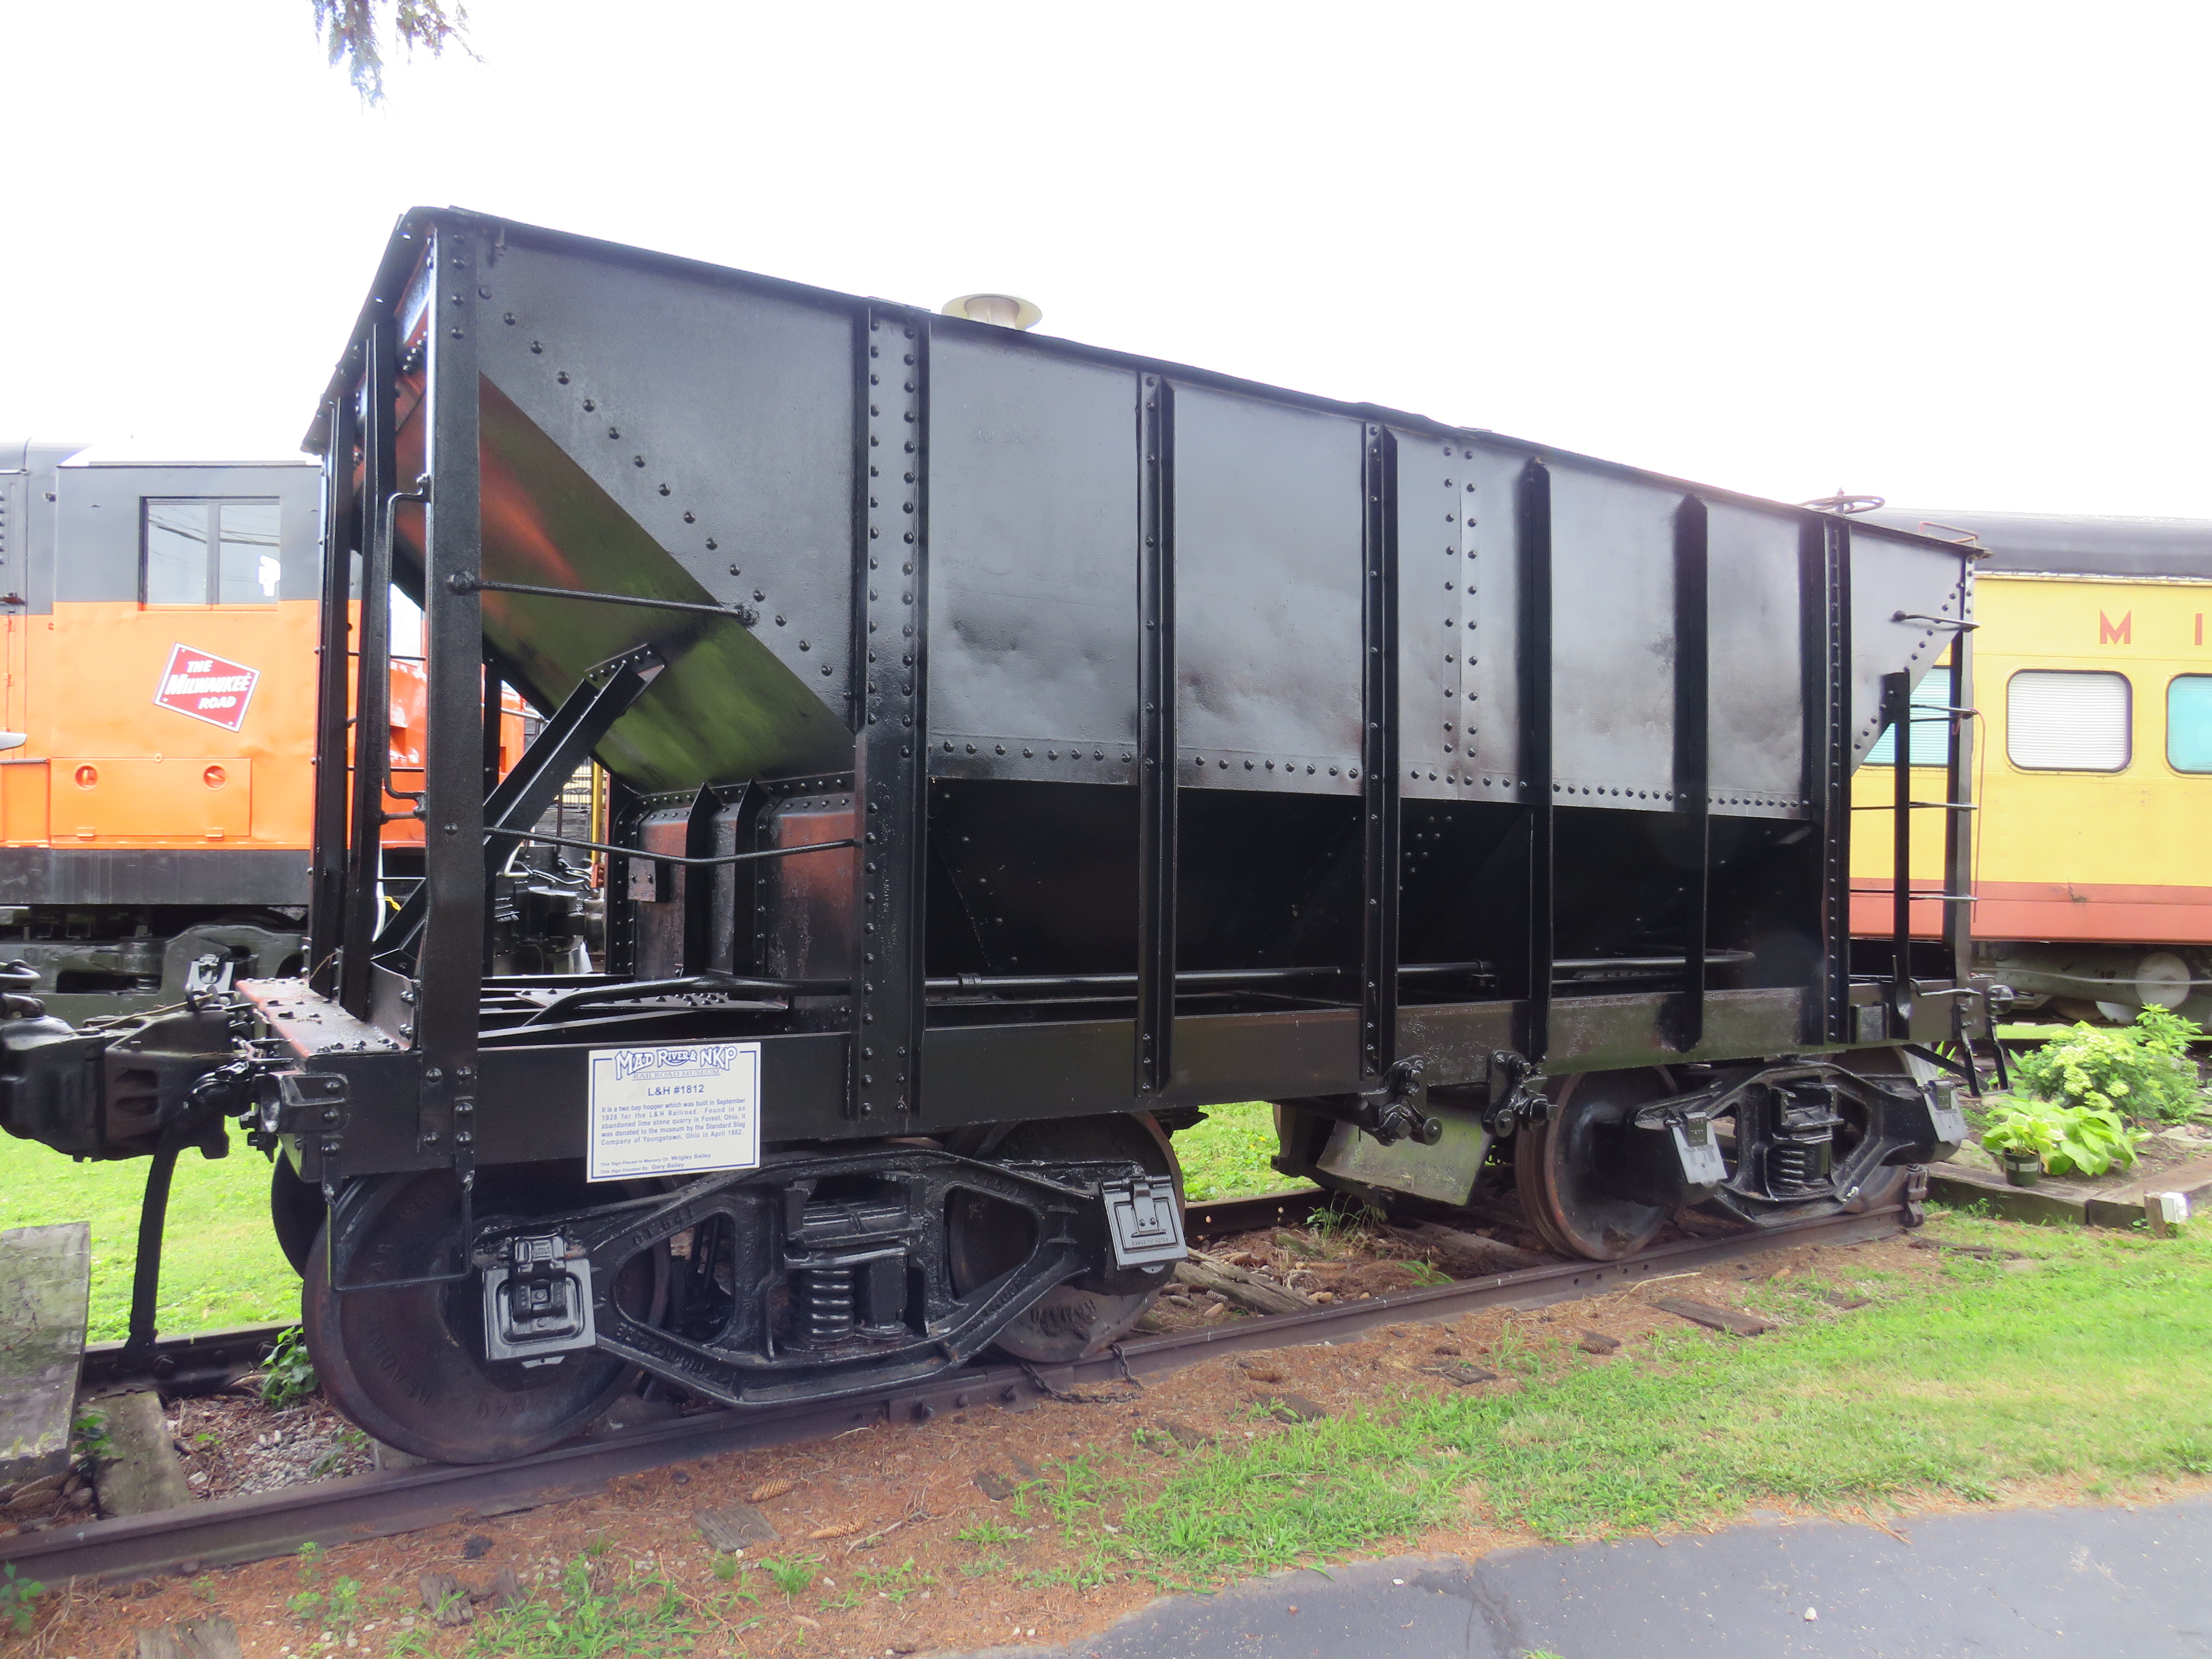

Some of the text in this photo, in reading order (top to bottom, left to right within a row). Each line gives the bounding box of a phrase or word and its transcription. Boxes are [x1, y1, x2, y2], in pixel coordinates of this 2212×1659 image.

[186, 660, 214, 673] THE
[164, 673, 252, 695] MILWAUKEE
[198, 696, 237, 710] ROAD
[614, 1051, 655, 1080] MAD
[700, 1046, 738, 1071] NKP
[633, 1071, 680, 1079] RAILROAD
[648, 1084, 704, 1096] L&H #1812
[716, 1097, 746, 1106] September
[601, 1121, 636, 1129] abandoned
[643, 1135, 683, 1143] Youngstown,
